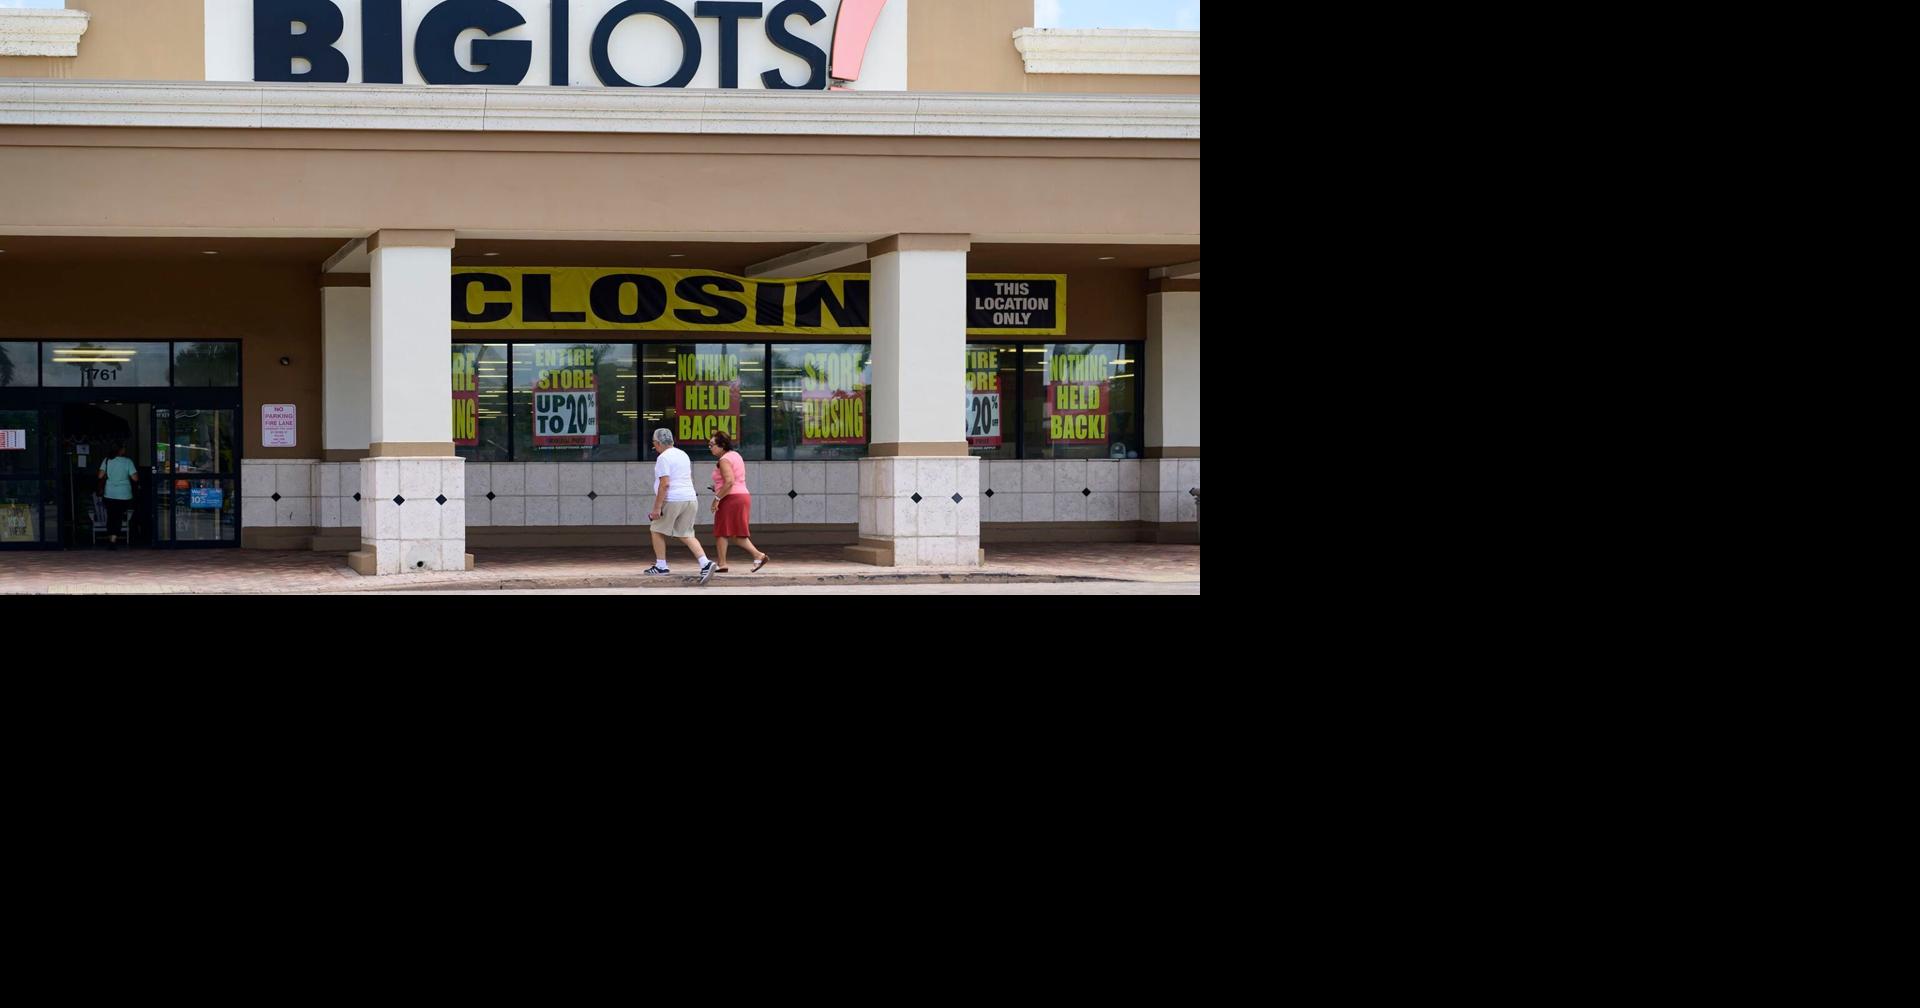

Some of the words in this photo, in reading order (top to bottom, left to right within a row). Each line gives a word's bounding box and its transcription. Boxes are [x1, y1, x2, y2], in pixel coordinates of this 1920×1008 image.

[253, 0, 532, 86] BIG
[994, 282, 1030, 296] THIS
[975, 297, 1049, 311] LOCATION
[993, 312, 1032, 325] ONLY
[535, 350, 595, 367] ENTIRE
[677, 353, 738, 381] NOTHING
[1049, 353, 1108, 381] NOTHING
[538, 369, 594, 389] STORE
[804, 352, 862, 391] STORE
[536, 394, 566, 413] UP
[685, 385, 730, 410] HELD
[1056, 385, 1100, 410] HELD
[537, 415, 564, 433] TO
[679, 414, 737, 440] BACK!
[804, 398, 864, 438] CLOSING
[1050, 414, 1107, 439] BACK!
